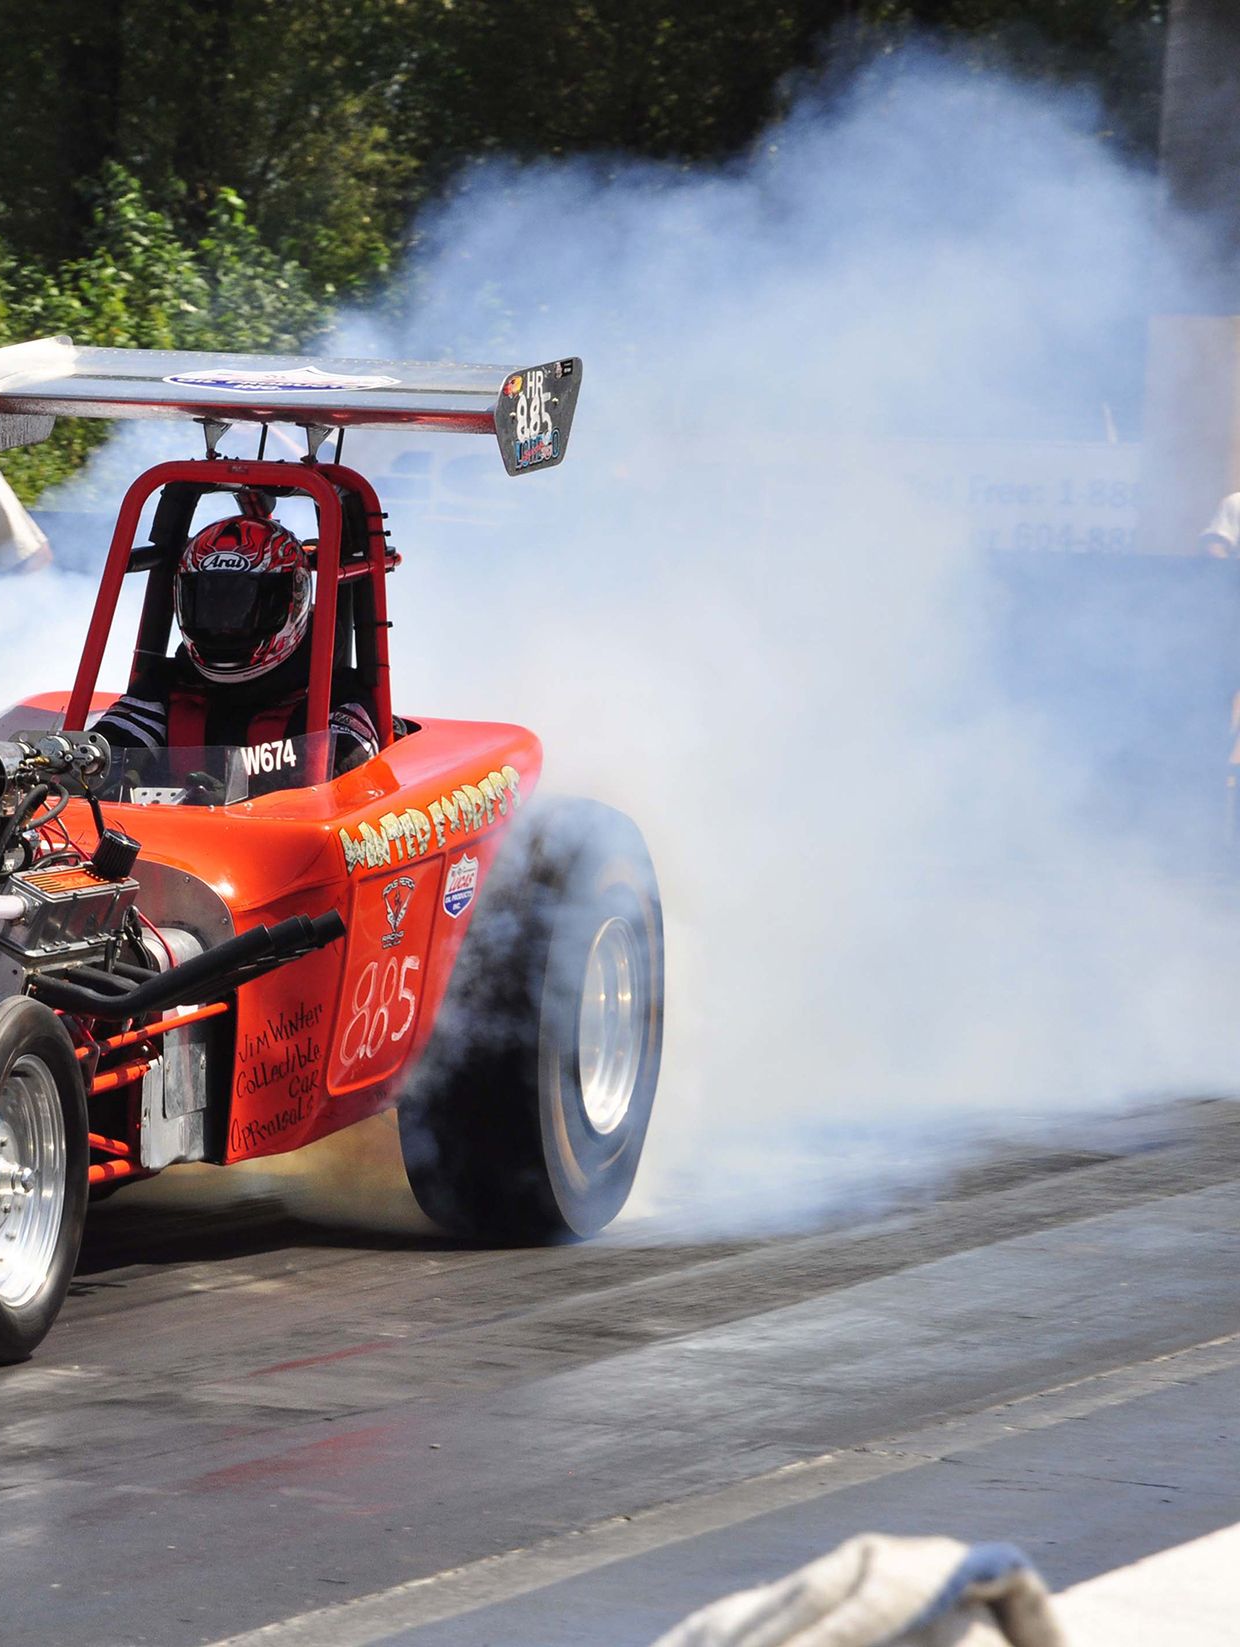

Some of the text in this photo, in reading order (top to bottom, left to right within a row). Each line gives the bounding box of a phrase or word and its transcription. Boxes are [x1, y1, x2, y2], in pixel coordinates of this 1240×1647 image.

[527, 371, 544, 399] HR
[209, 555, 244, 568] Arai
[241, 738, 297, 776] W674
[338, 807, 432, 876] WINTER
